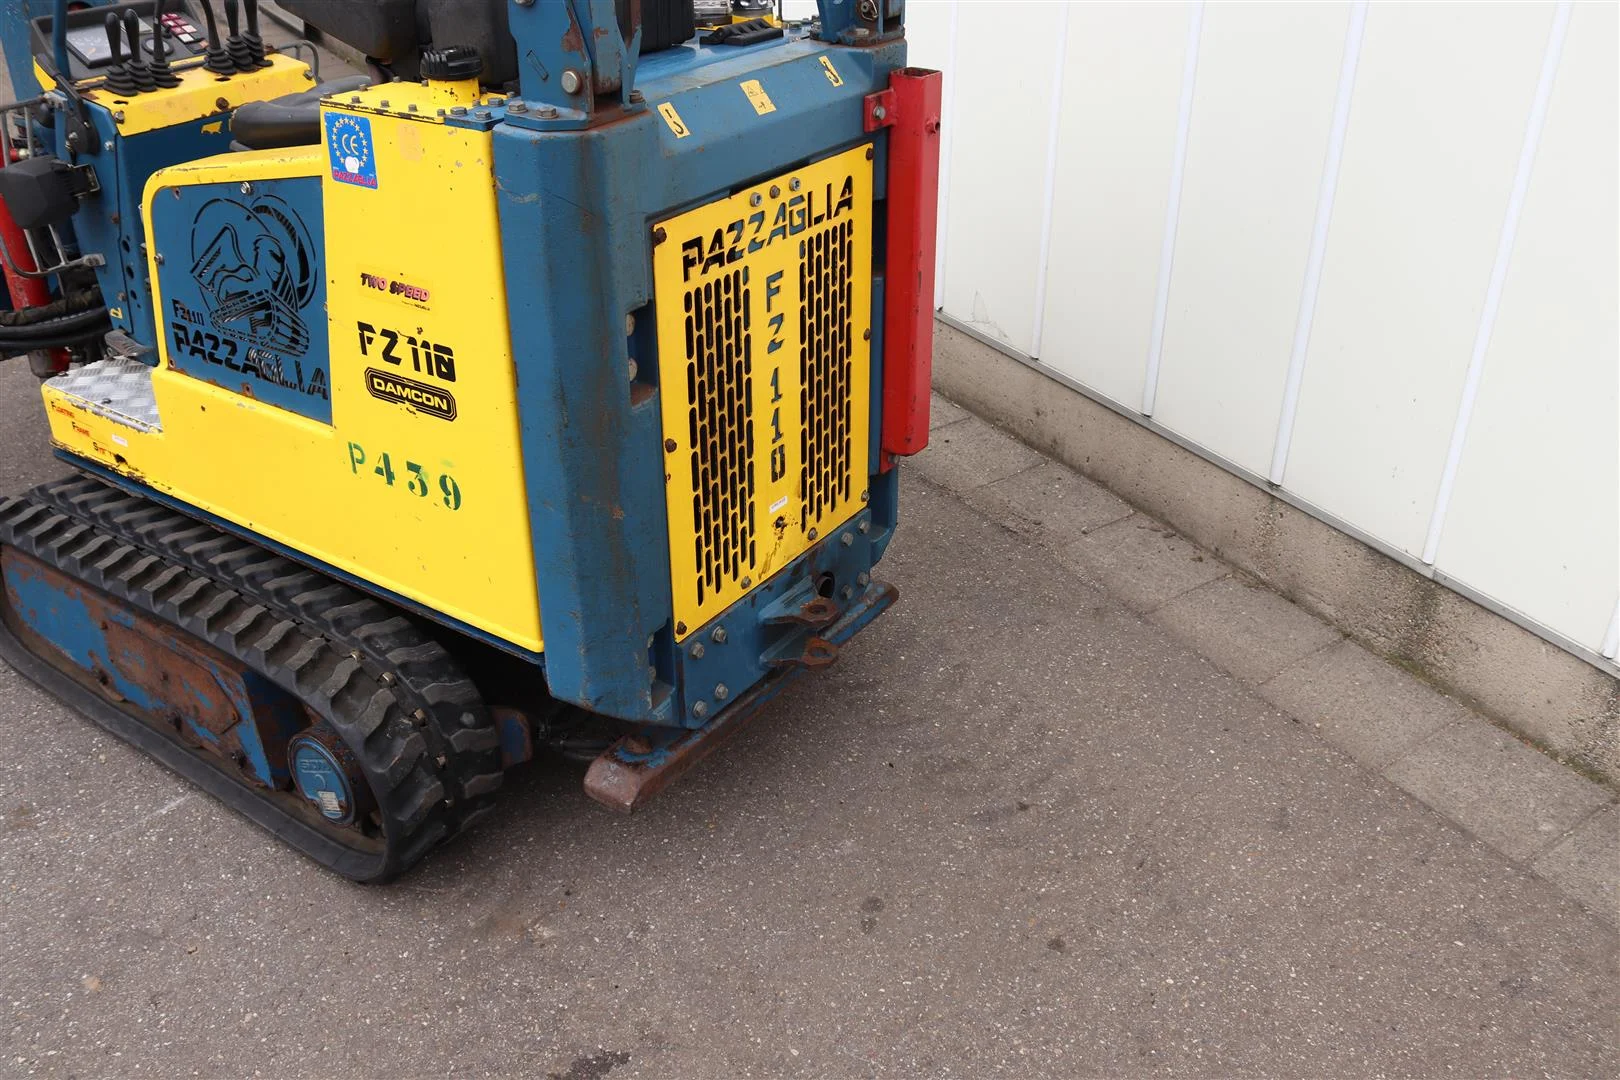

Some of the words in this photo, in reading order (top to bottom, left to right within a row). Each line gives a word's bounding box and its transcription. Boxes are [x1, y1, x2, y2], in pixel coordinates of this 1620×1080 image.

[681, 175, 854, 283] PAZZAGLIA
[360, 272, 388, 291] TWO
[389, 280, 431, 303] SPEED
[171, 321, 329, 401] PAZZAGLIA
[373, 377, 448, 411] DAMCON
